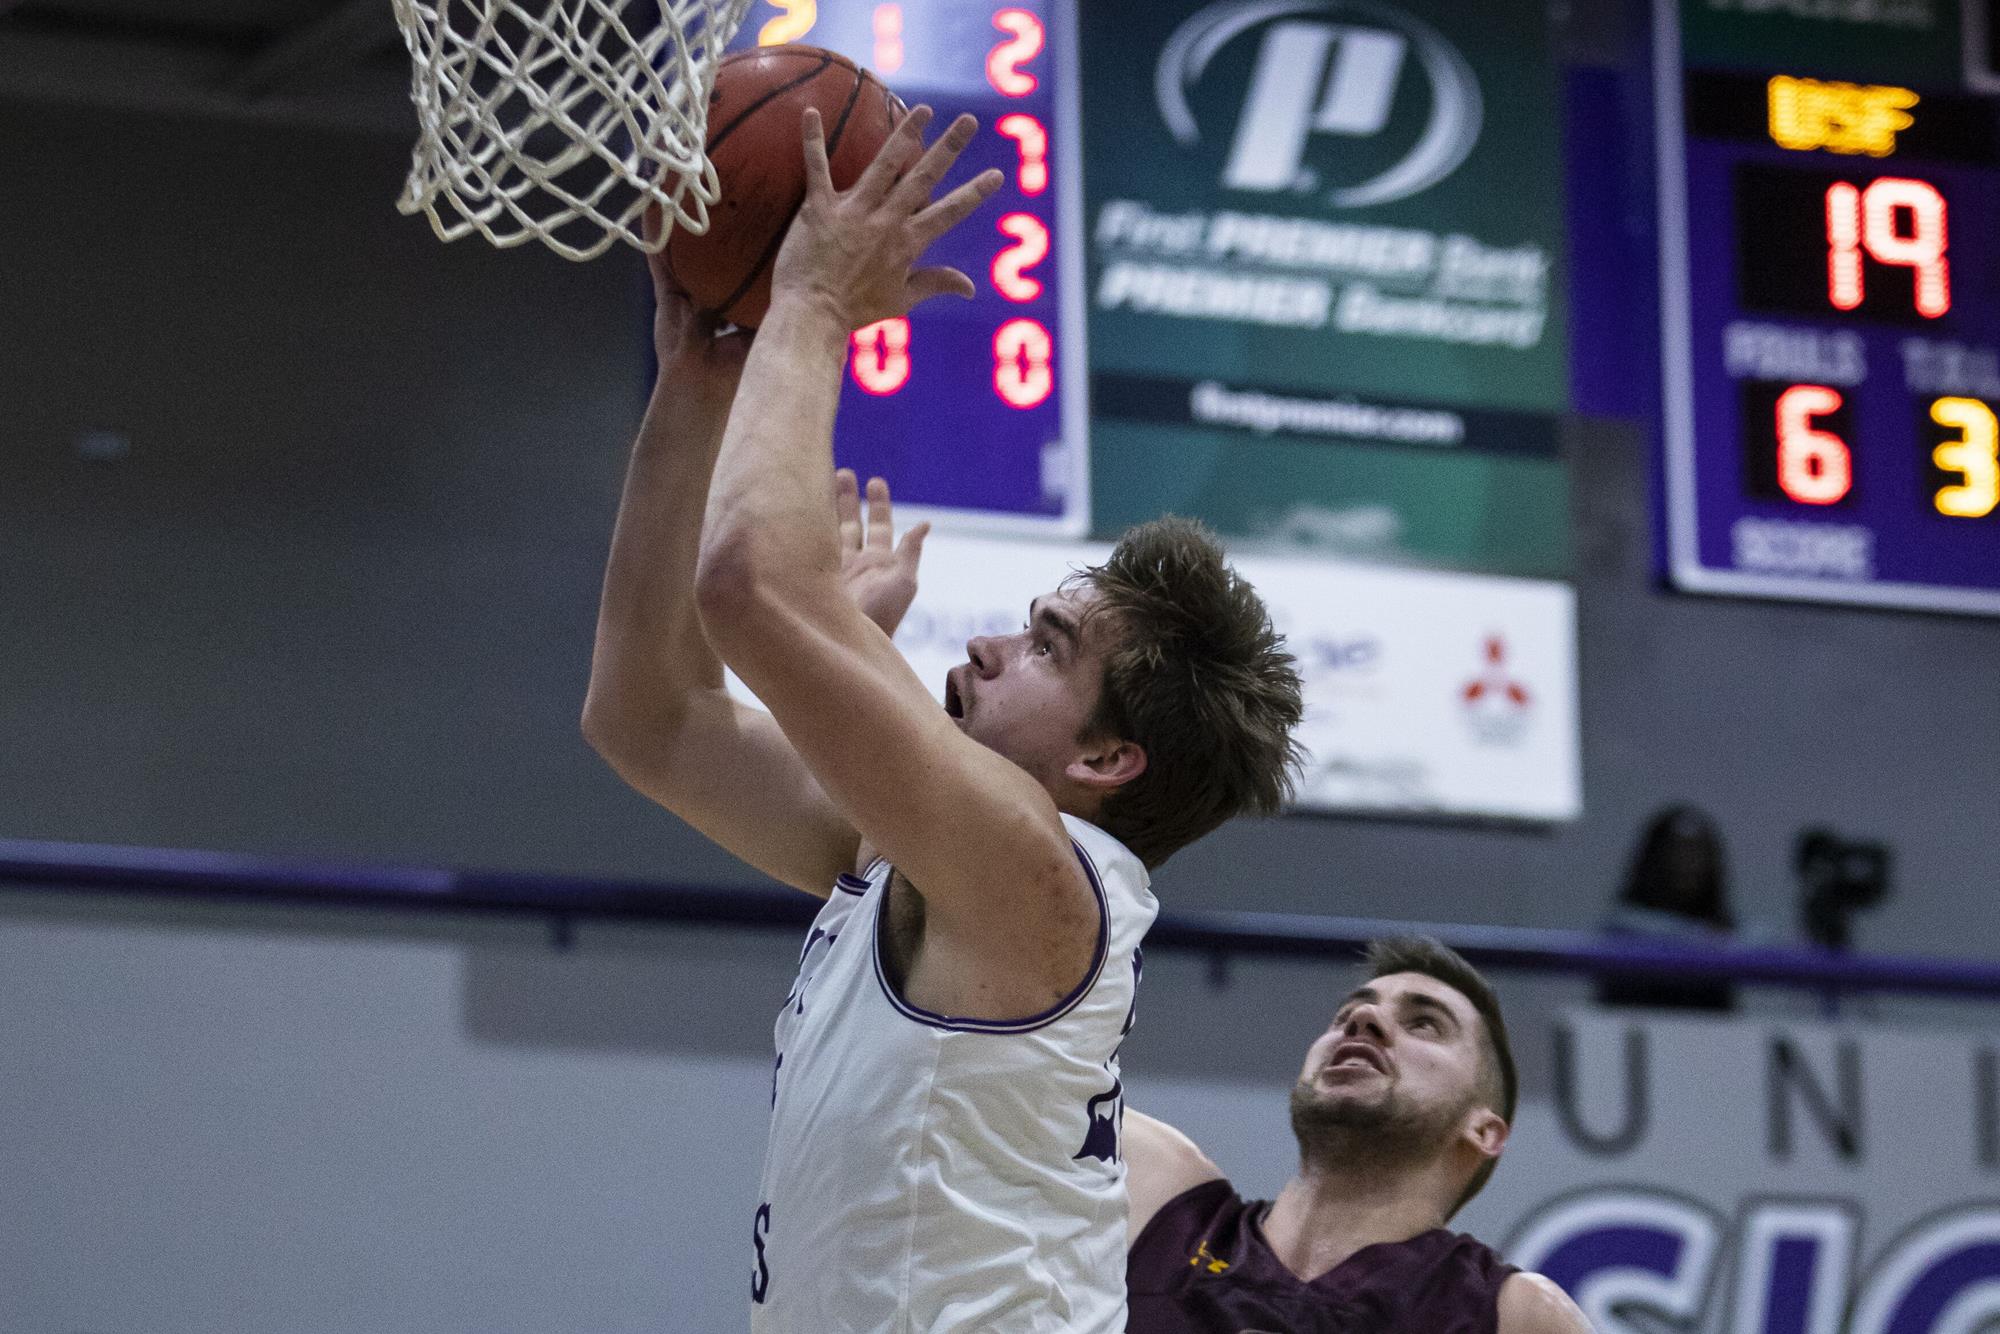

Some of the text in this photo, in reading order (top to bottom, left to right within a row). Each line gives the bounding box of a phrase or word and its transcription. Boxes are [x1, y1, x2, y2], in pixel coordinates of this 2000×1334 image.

[985, 7, 1045, 97] 2
[994, 112, 1048, 195] 7
[989, 211, 1050, 303] 2
[1208, 210, 1436, 274] PREMIER
[1825, 176, 1950, 318] 19
[1098, 259, 1331, 328] PREMIER
[992, 317, 1054, 410] 0
[1775, 384, 1853, 506] 6
[1929, 396, 2000, 518] 3
